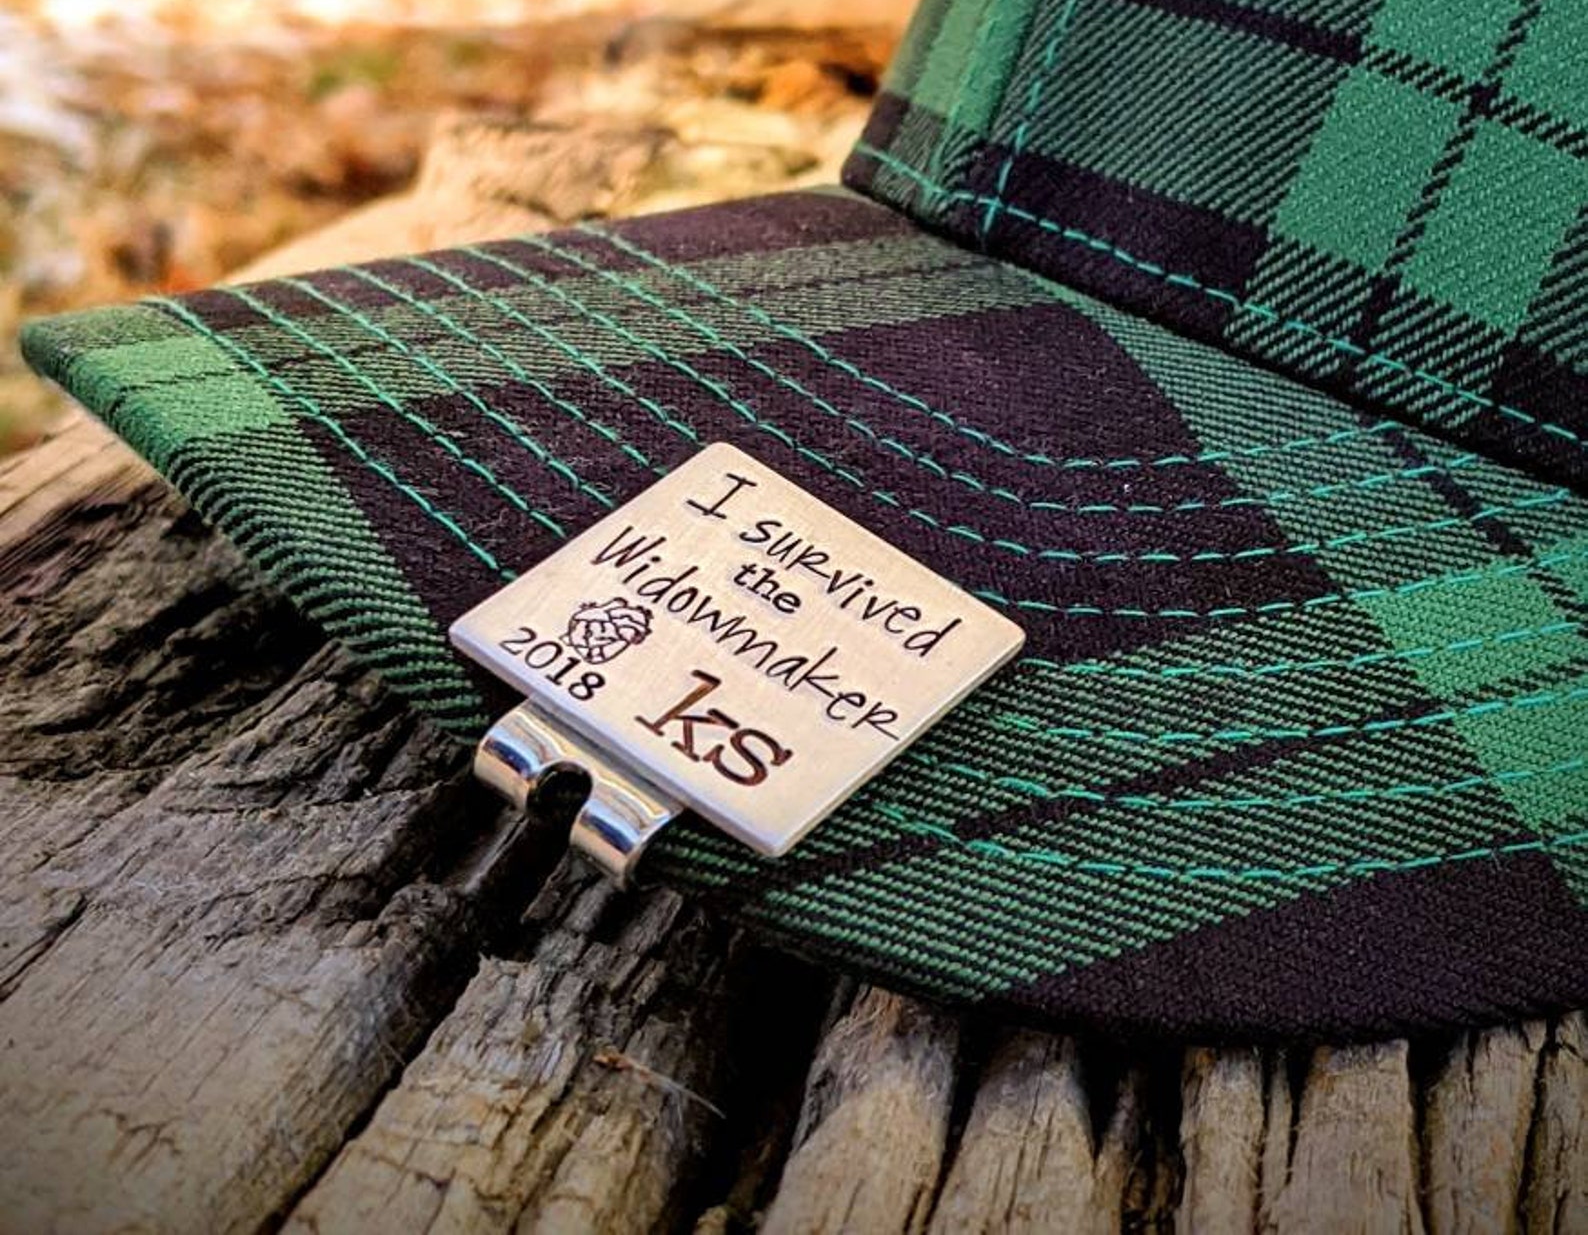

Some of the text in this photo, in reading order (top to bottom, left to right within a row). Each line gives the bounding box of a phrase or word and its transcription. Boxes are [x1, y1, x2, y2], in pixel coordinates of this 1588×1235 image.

[686, 472, 757, 519] I
[733, 562, 802, 615] the
[499, 626, 607, 702] 2018
